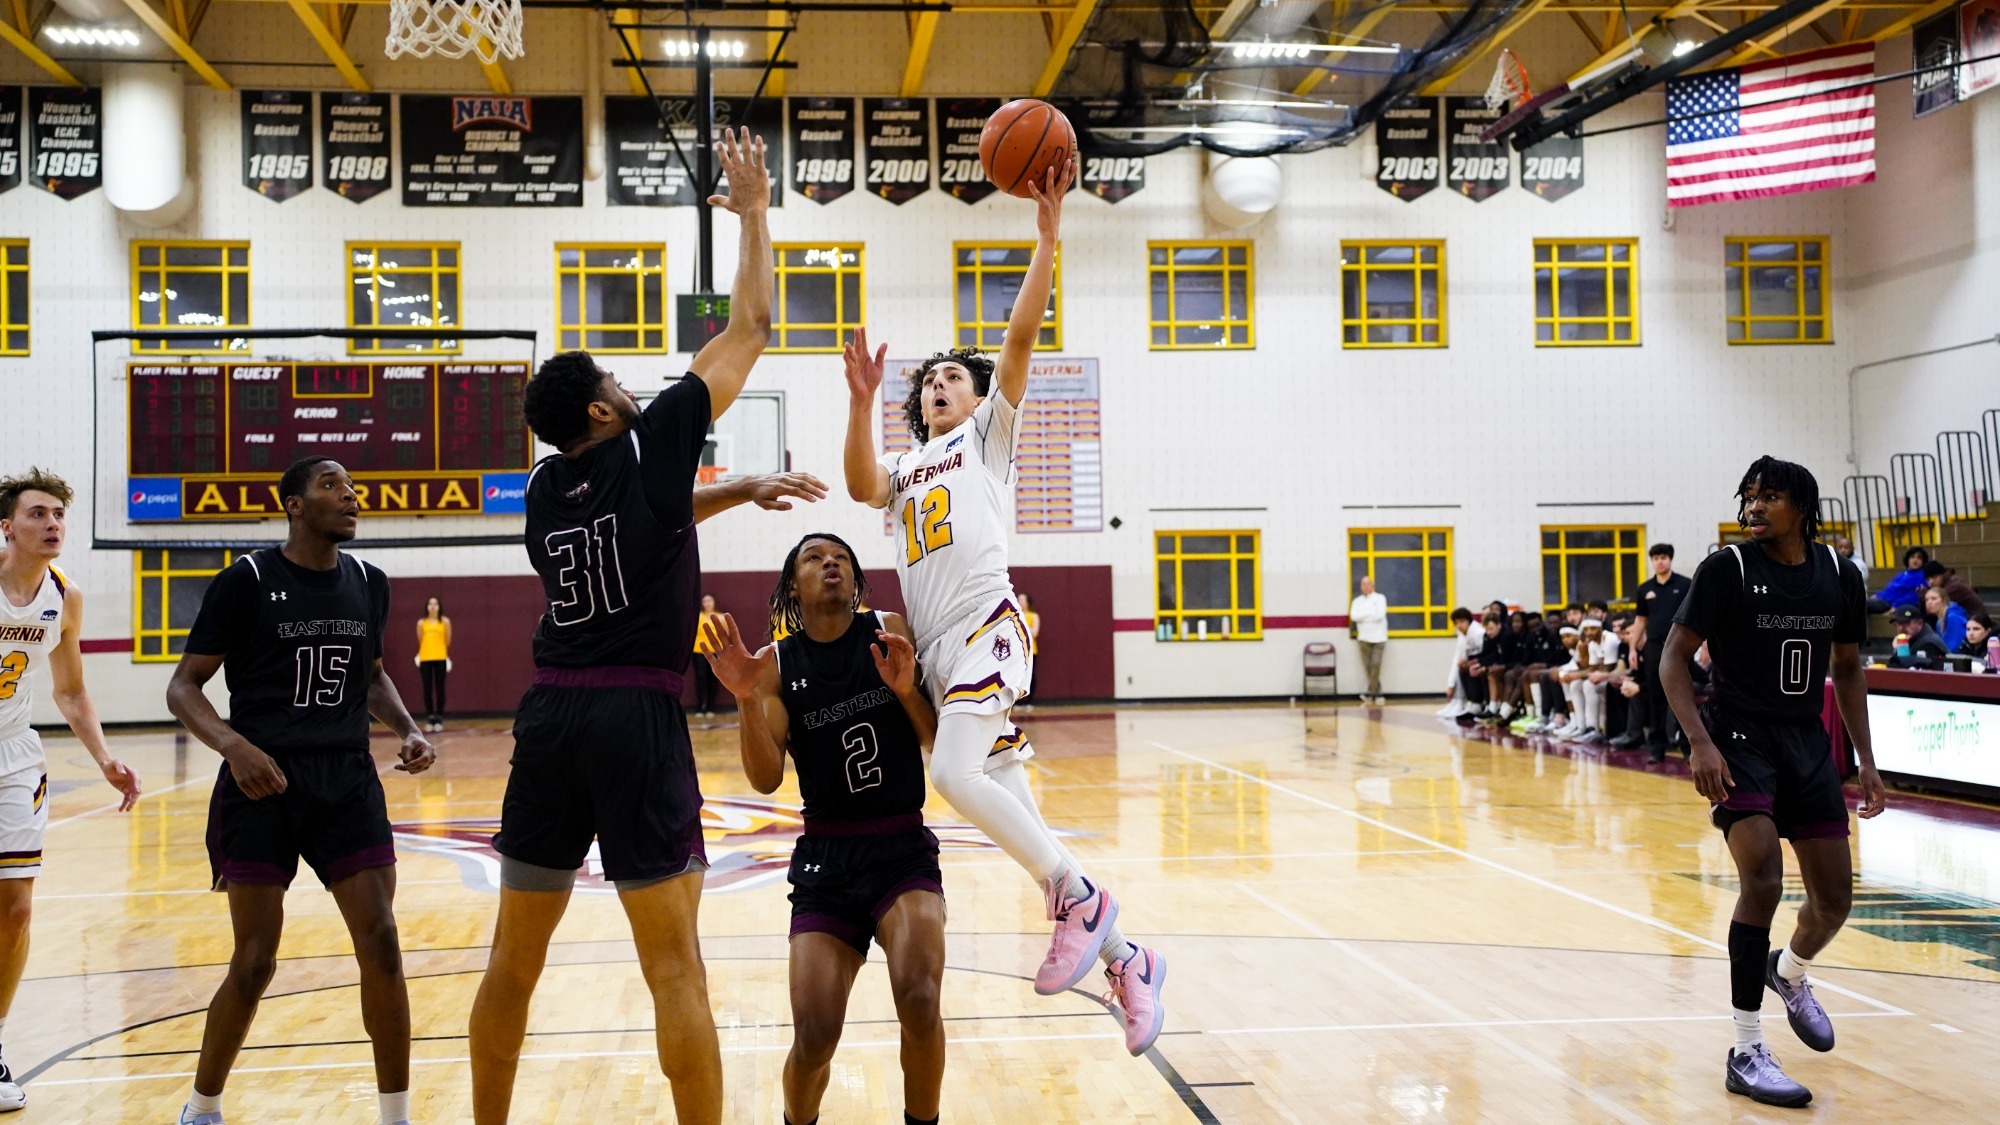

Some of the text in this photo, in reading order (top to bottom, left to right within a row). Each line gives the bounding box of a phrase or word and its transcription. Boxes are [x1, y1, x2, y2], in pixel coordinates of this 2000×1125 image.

[42, 102, 92, 114] Women's
[251, 103, 303, 114] CHAMPIONS
[330, 105, 383, 116] CHAMPIONS
[455, 99, 528, 125] NAIA
[38, 113, 97, 126] Basketball
[798, 110, 847, 120] CHAMPIONS
[872, 110, 921, 120] CHAMPIONS
[254, 123, 300, 136] Baseball
[333, 120, 380, 132] Women's
[881, 125, 911, 136] Men's
[328, 131, 384, 143] Basketball
[801, 130, 843, 141] Baseball
[1387, 128, 1428, 140] Baseball
[41, 137, 94, 150] Champions
[871, 136, 922, 147] Basketball
[36, 151, 99, 177] 1995
[249, 154, 310, 179] 1995
[329, 155, 389, 181] 1998
[1084, 157, 1144, 182] 2002
[1380, 156, 1439, 180] 2003
[1449, 156, 1509, 180] 2003
[1523, 156, 1582, 180] 2004
[796, 159, 852, 183] 1998
[868, 159, 929, 183] 2000
[133, 366, 219, 376] PLAYER FOULS POINTS
[232, 367, 283, 381] GUEST
[383, 366, 427, 380] HOME
[444, 365, 526, 375] PLAYER FOULS POINTS
[294, 407, 338, 419] PERIOD
[245, 434, 275, 443] FOULS
[297, 433, 369, 443] TIME OUTS LEFT
[391, 432, 421, 442] FOULS
[147, 493, 178, 505] pepsi
[194, 480, 471, 513] ALVRNIA
[501, 489, 526, 500] peps
[902, 484, 954, 568] 12
[545, 513, 629, 627] 31
[1757, 614, 1835, 629] EASTERN
[278, 619, 367, 638] EASTERN
[1780, 639, 1811, 695] 0
[0, 650, 29, 700] 2
[294, 645, 351, 707] 15
[803, 686, 897, 729] EASTERN
[842, 722, 882, 794] 2
